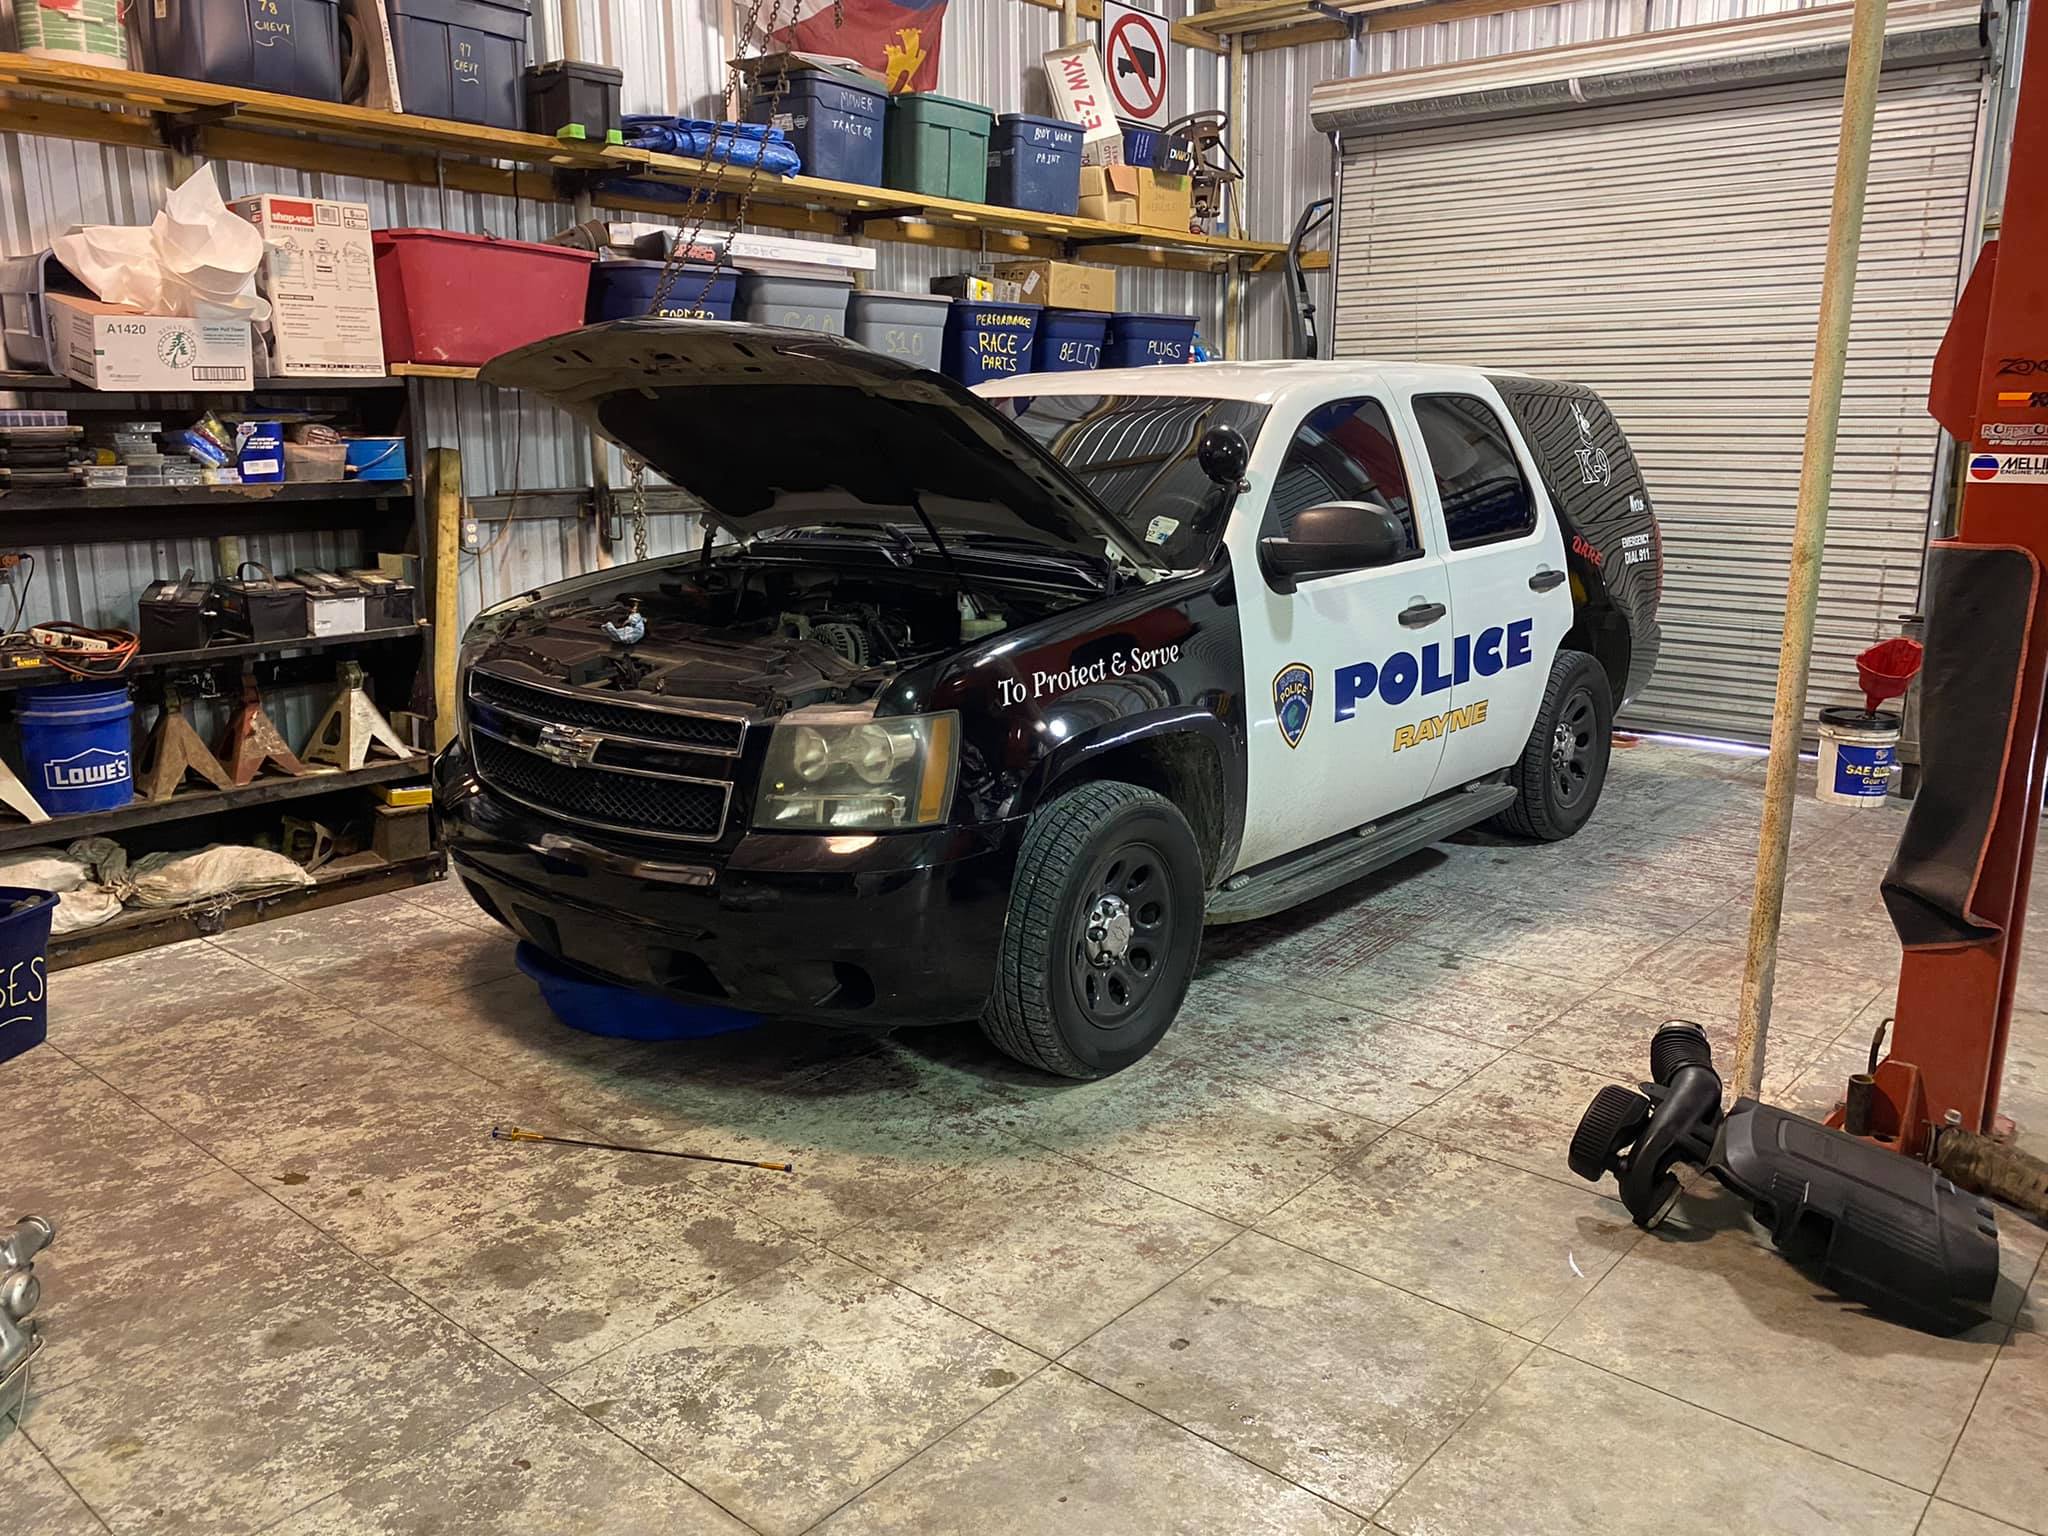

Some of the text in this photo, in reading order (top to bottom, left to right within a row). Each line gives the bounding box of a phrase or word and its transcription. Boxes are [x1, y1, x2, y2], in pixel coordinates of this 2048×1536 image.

[254, 20, 291, 35] CHEVY
[459, 42, 472, 57] 97
[454, 59, 479, 76] CHEVY
[1061, 55, 1090, 91] MIX
[840, 91, 873, 113] MOWER
[832, 119, 873, 141] TRACTOR
[1035, 153, 1061, 165] PAINT
[106, 323, 147, 335] A1420
[975, 313, 1032, 328] PERFORMANCE
[979, 332, 1018, 355] RACE
[1147, 340, 1182, 359] PLUGS
[981, 356, 1017, 372] PARTS
[1059, 342, 1101, 370] BELTS
[1574, 447, 1611, 487] K-9
[2000, 457, 2048, 470] MELLI
[1572, 535, 1604, 566] DARE
[1624, 548, 1650, 565] DIAL 911
[998, 644, 1180, 707] To Protect & Serve
[1334, 617, 1533, 723] POLICE
[1280, 682, 1308, 703] POLICE
[1392, 699, 1489, 753] RAYNE
[54, 759, 127, 785] LOWE'S
[1846, 764, 1872, 776] SAE
